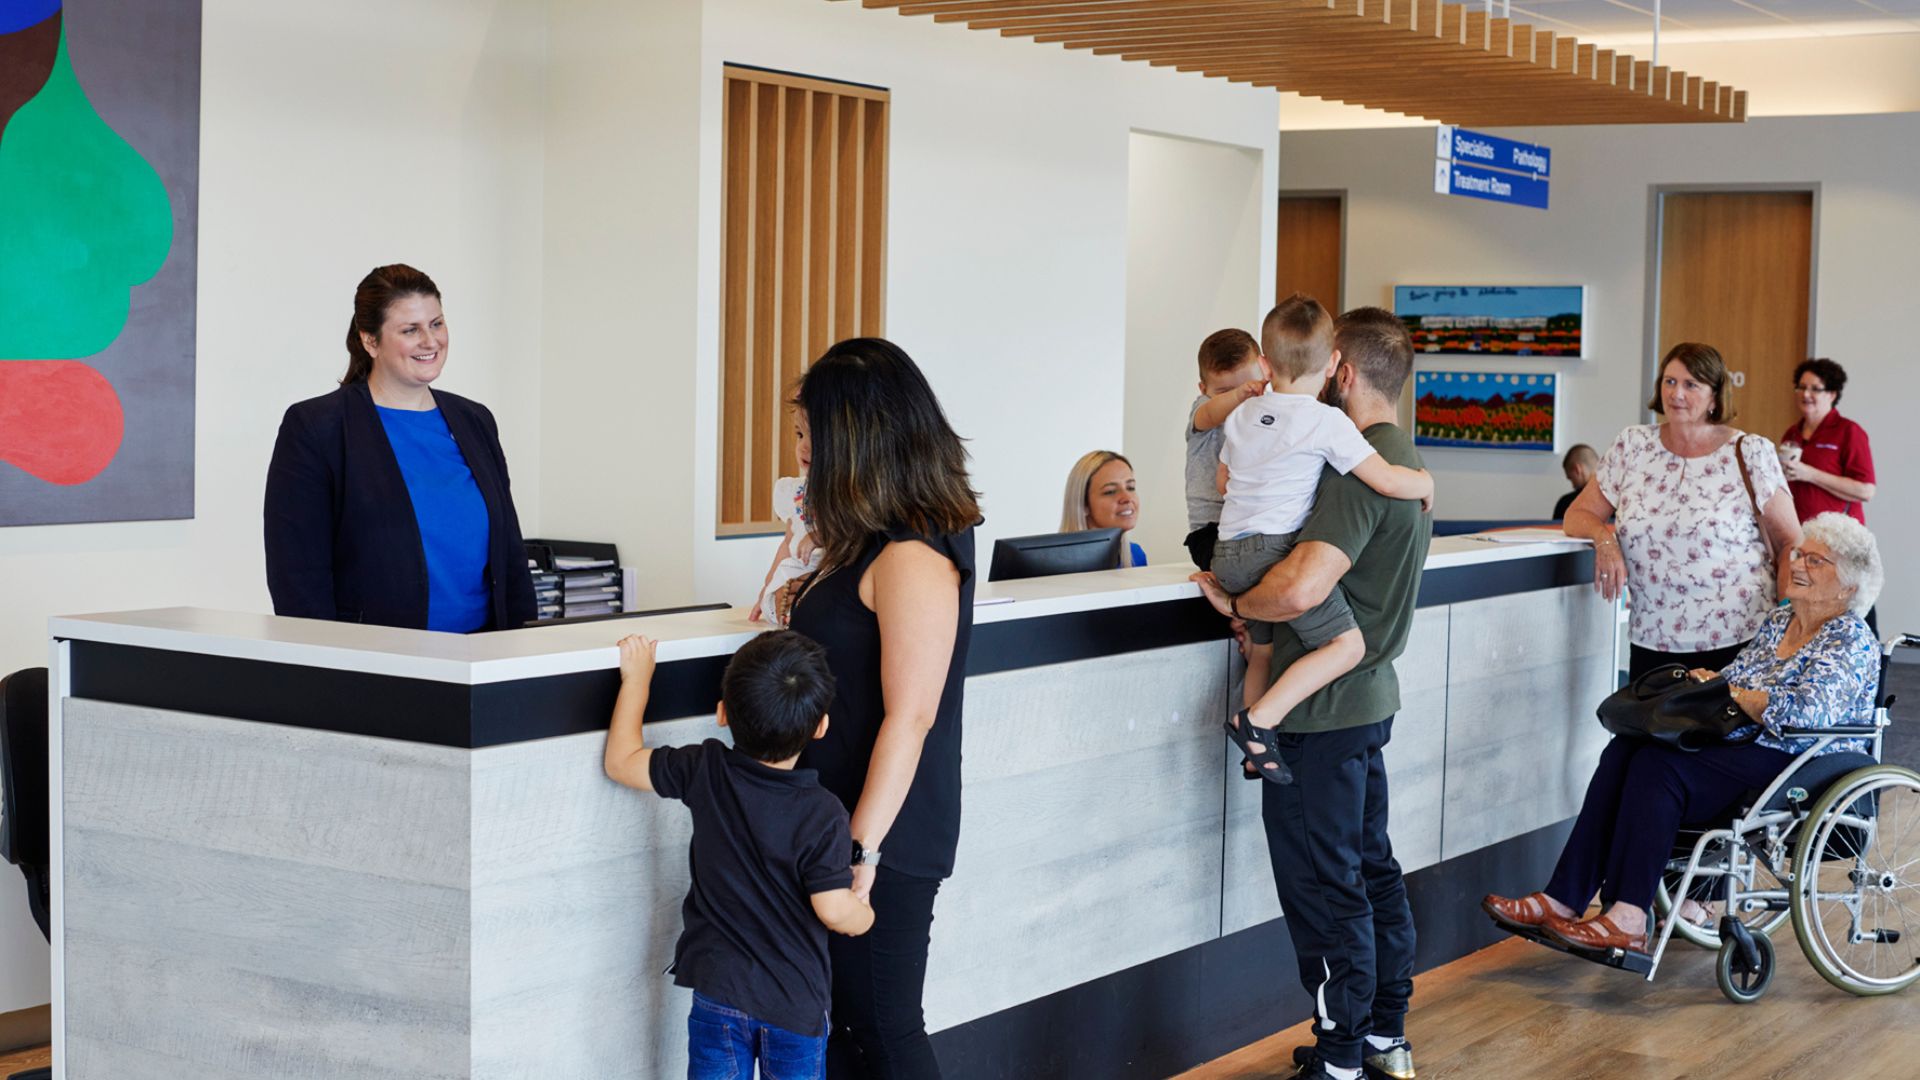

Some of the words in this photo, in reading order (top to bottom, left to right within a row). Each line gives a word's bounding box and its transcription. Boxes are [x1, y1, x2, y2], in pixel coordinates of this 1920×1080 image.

[1455, 135, 1495, 159] Specialists
[1513, 147, 1547, 173] Pathology
[1453, 170, 1490, 193] Treatment
[1490, 177, 1511, 196] Room
